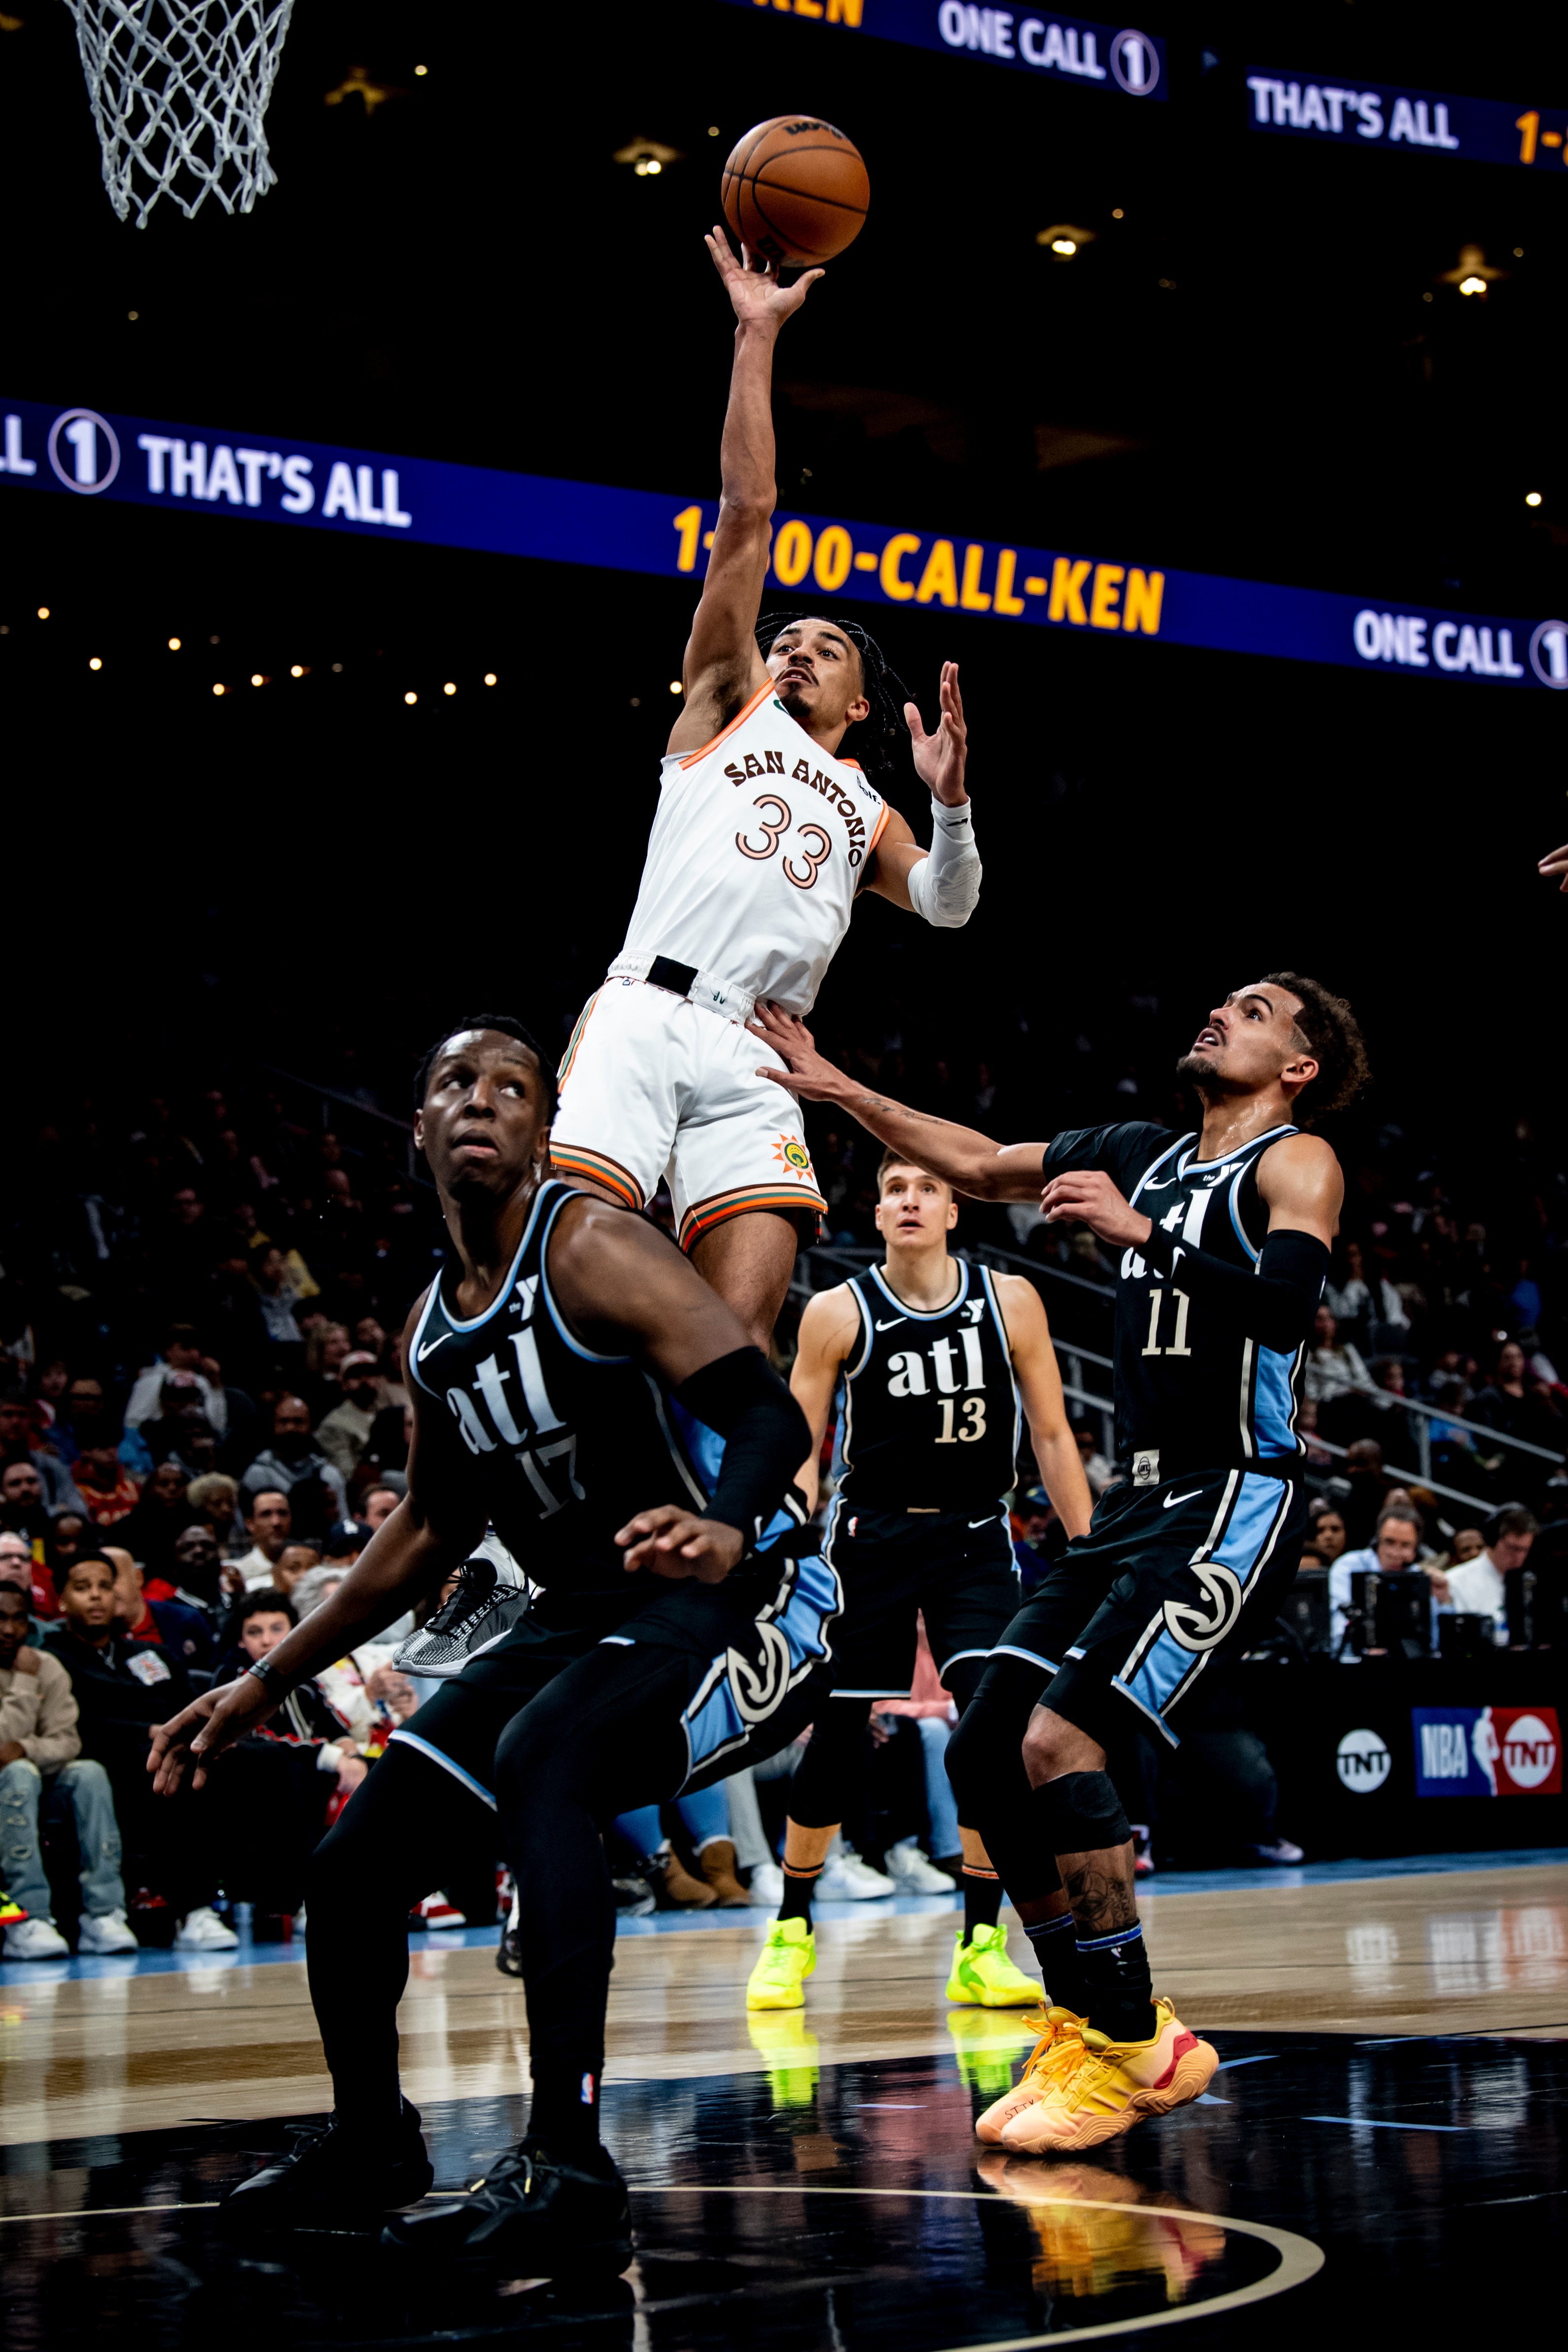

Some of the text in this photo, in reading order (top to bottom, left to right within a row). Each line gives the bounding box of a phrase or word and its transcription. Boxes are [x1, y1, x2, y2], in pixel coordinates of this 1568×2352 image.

[937, 0, 1016, 59] ONE
[1018, 18, 1106, 80] CALL
[1247, 75, 1460, 149] THAT'S ALL
[1515, 110, 1568, 168] 1-
[138, 433, 315, 514] THAT'S
[322, 462, 412, 528] ALL
[673, 504, 1165, 635] 1-00-CALL-KEN
[1353, 609, 1429, 668] ONE
[1432, 621, 1524, 678] CALL
[723, 750, 866, 867] SAN ANTONIO
[735, 794, 832, 890] 33
[1141, 1288, 1192, 1356] 11
[447, 1325, 567, 1455] atl
[888, 1326, 986, 1397] atl
[935, 1397, 986, 1443] 13
[515, 1434, 586, 1520] 17
[1420, 1724, 1468, 1779] NBA
